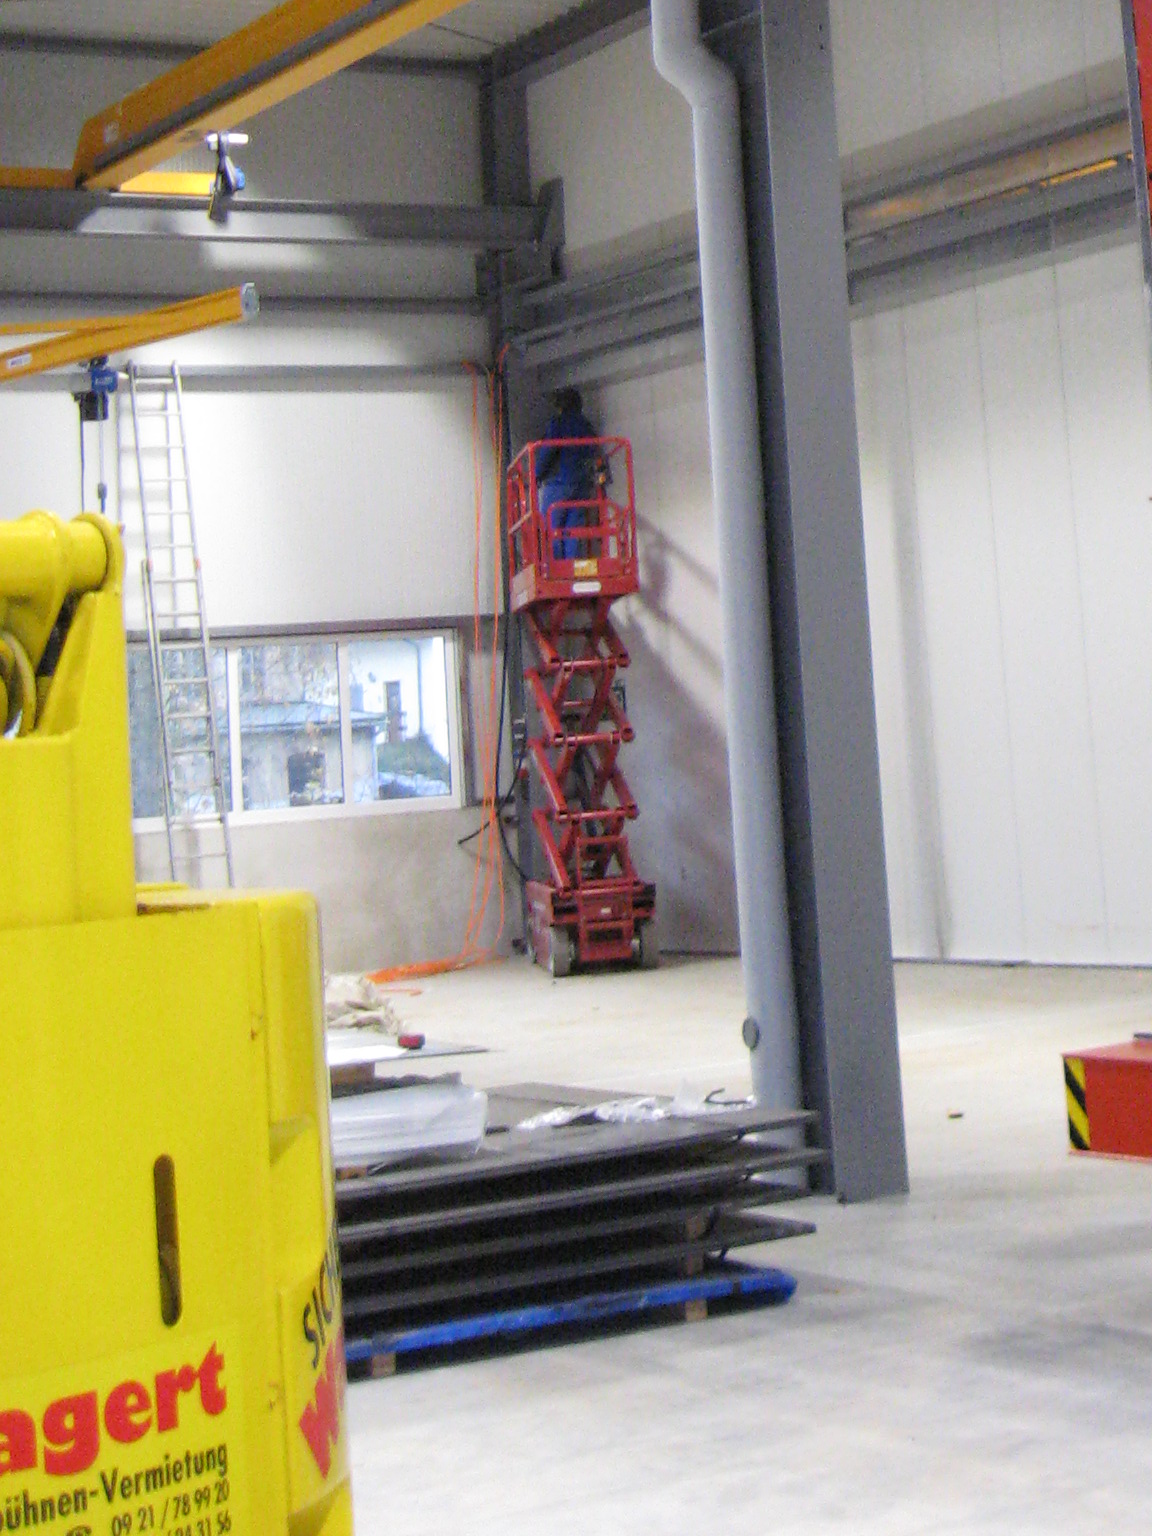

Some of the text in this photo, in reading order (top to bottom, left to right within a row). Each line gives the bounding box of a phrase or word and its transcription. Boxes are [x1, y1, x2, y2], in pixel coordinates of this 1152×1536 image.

[0, 1340, 227, 1476] agert
[0, 1443, 228, 1531] ühnen-Vermietung
[138, 1503, 155, 1531] 21
[173, 1492, 191, 1519] 78
[194, 1484, 211, 1511] 99
[214, 1476, 230, 1504] 20
